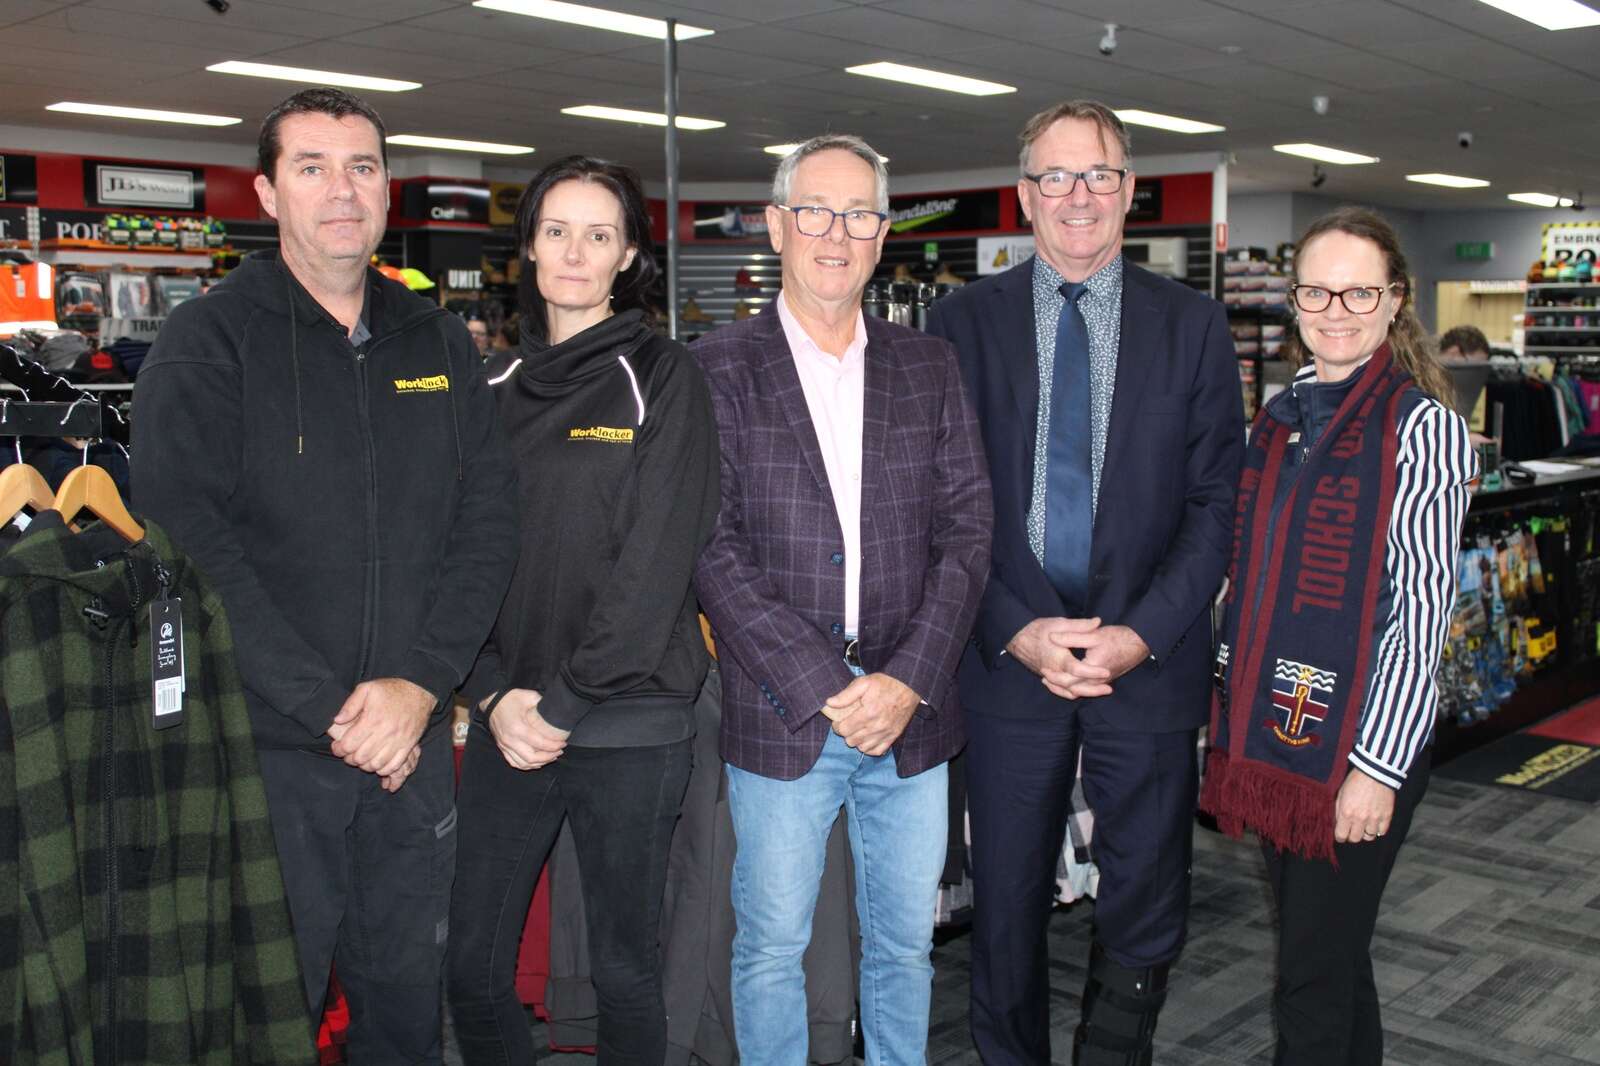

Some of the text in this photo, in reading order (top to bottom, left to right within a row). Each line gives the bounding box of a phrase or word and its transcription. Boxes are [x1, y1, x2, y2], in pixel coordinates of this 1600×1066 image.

[131, 320, 161, 332] TRA
[570, 426, 633, 440] Worklocker
[1291, 472, 1362, 616] SCHOOL
